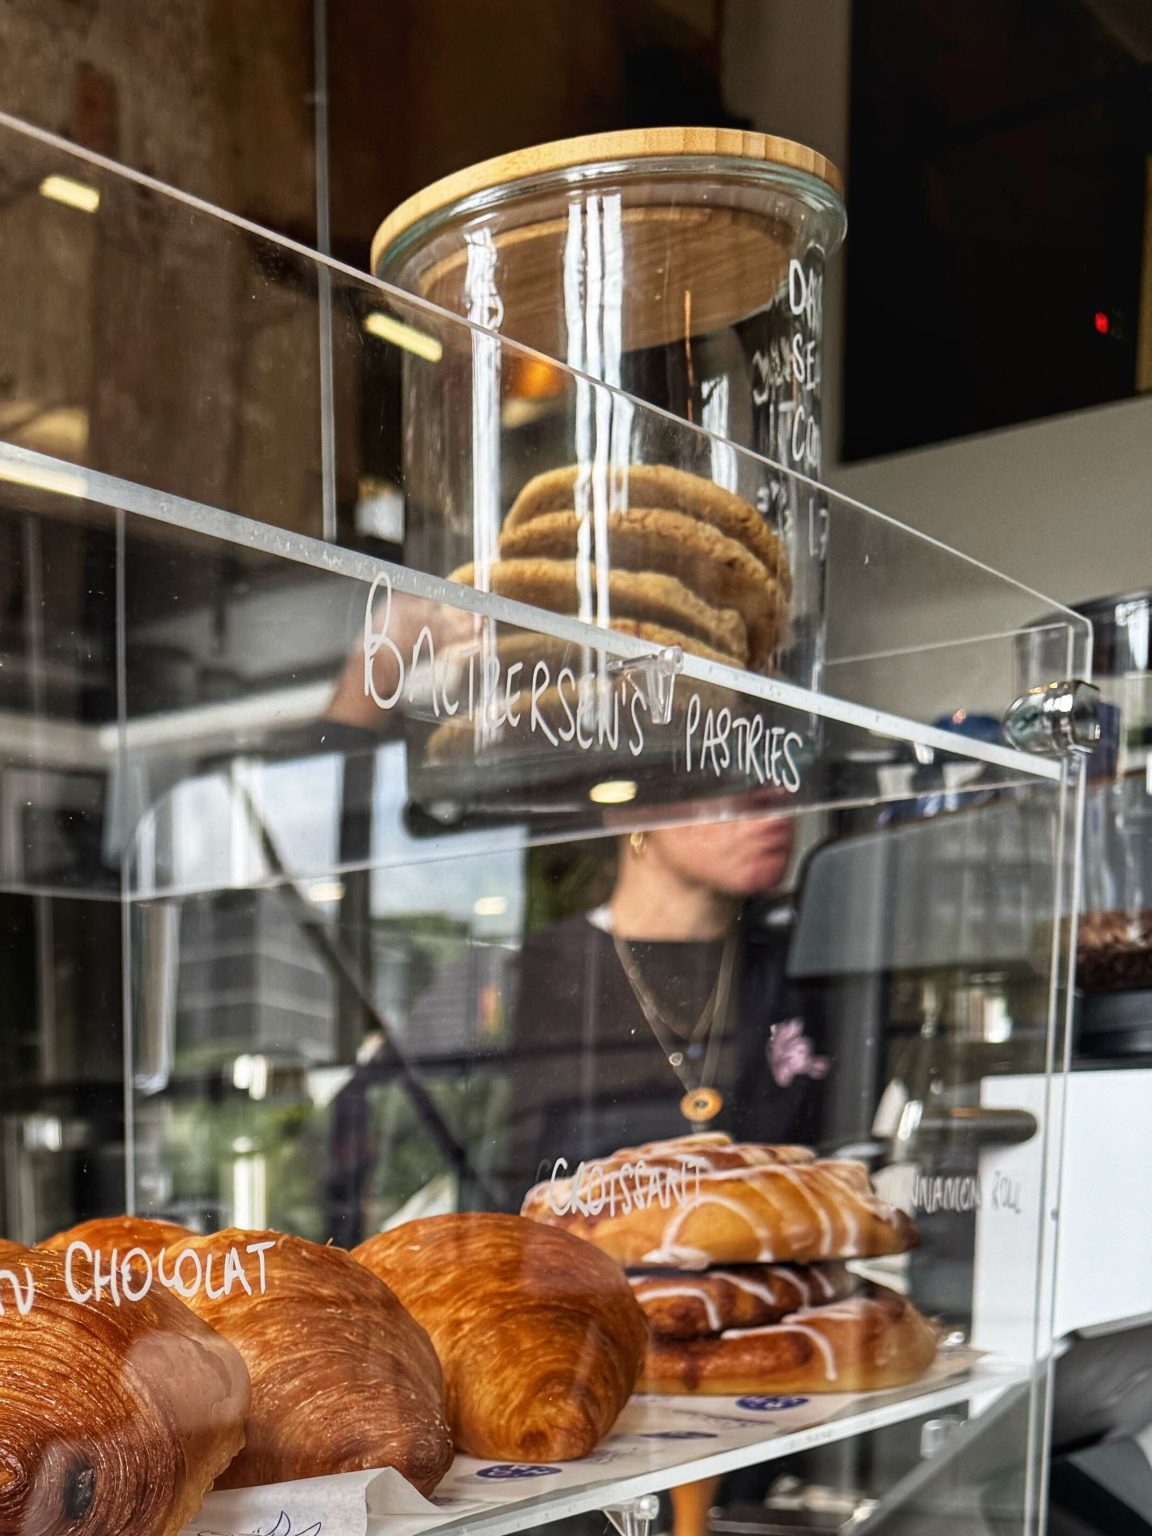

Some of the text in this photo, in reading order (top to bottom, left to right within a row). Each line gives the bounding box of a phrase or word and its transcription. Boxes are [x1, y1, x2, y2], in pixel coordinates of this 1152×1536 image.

[686, 693, 803, 793] PASTRIES
[550, 1157, 704, 1218] CROISSANT
[64, 1240, 276, 1307] CHOCOLAT
